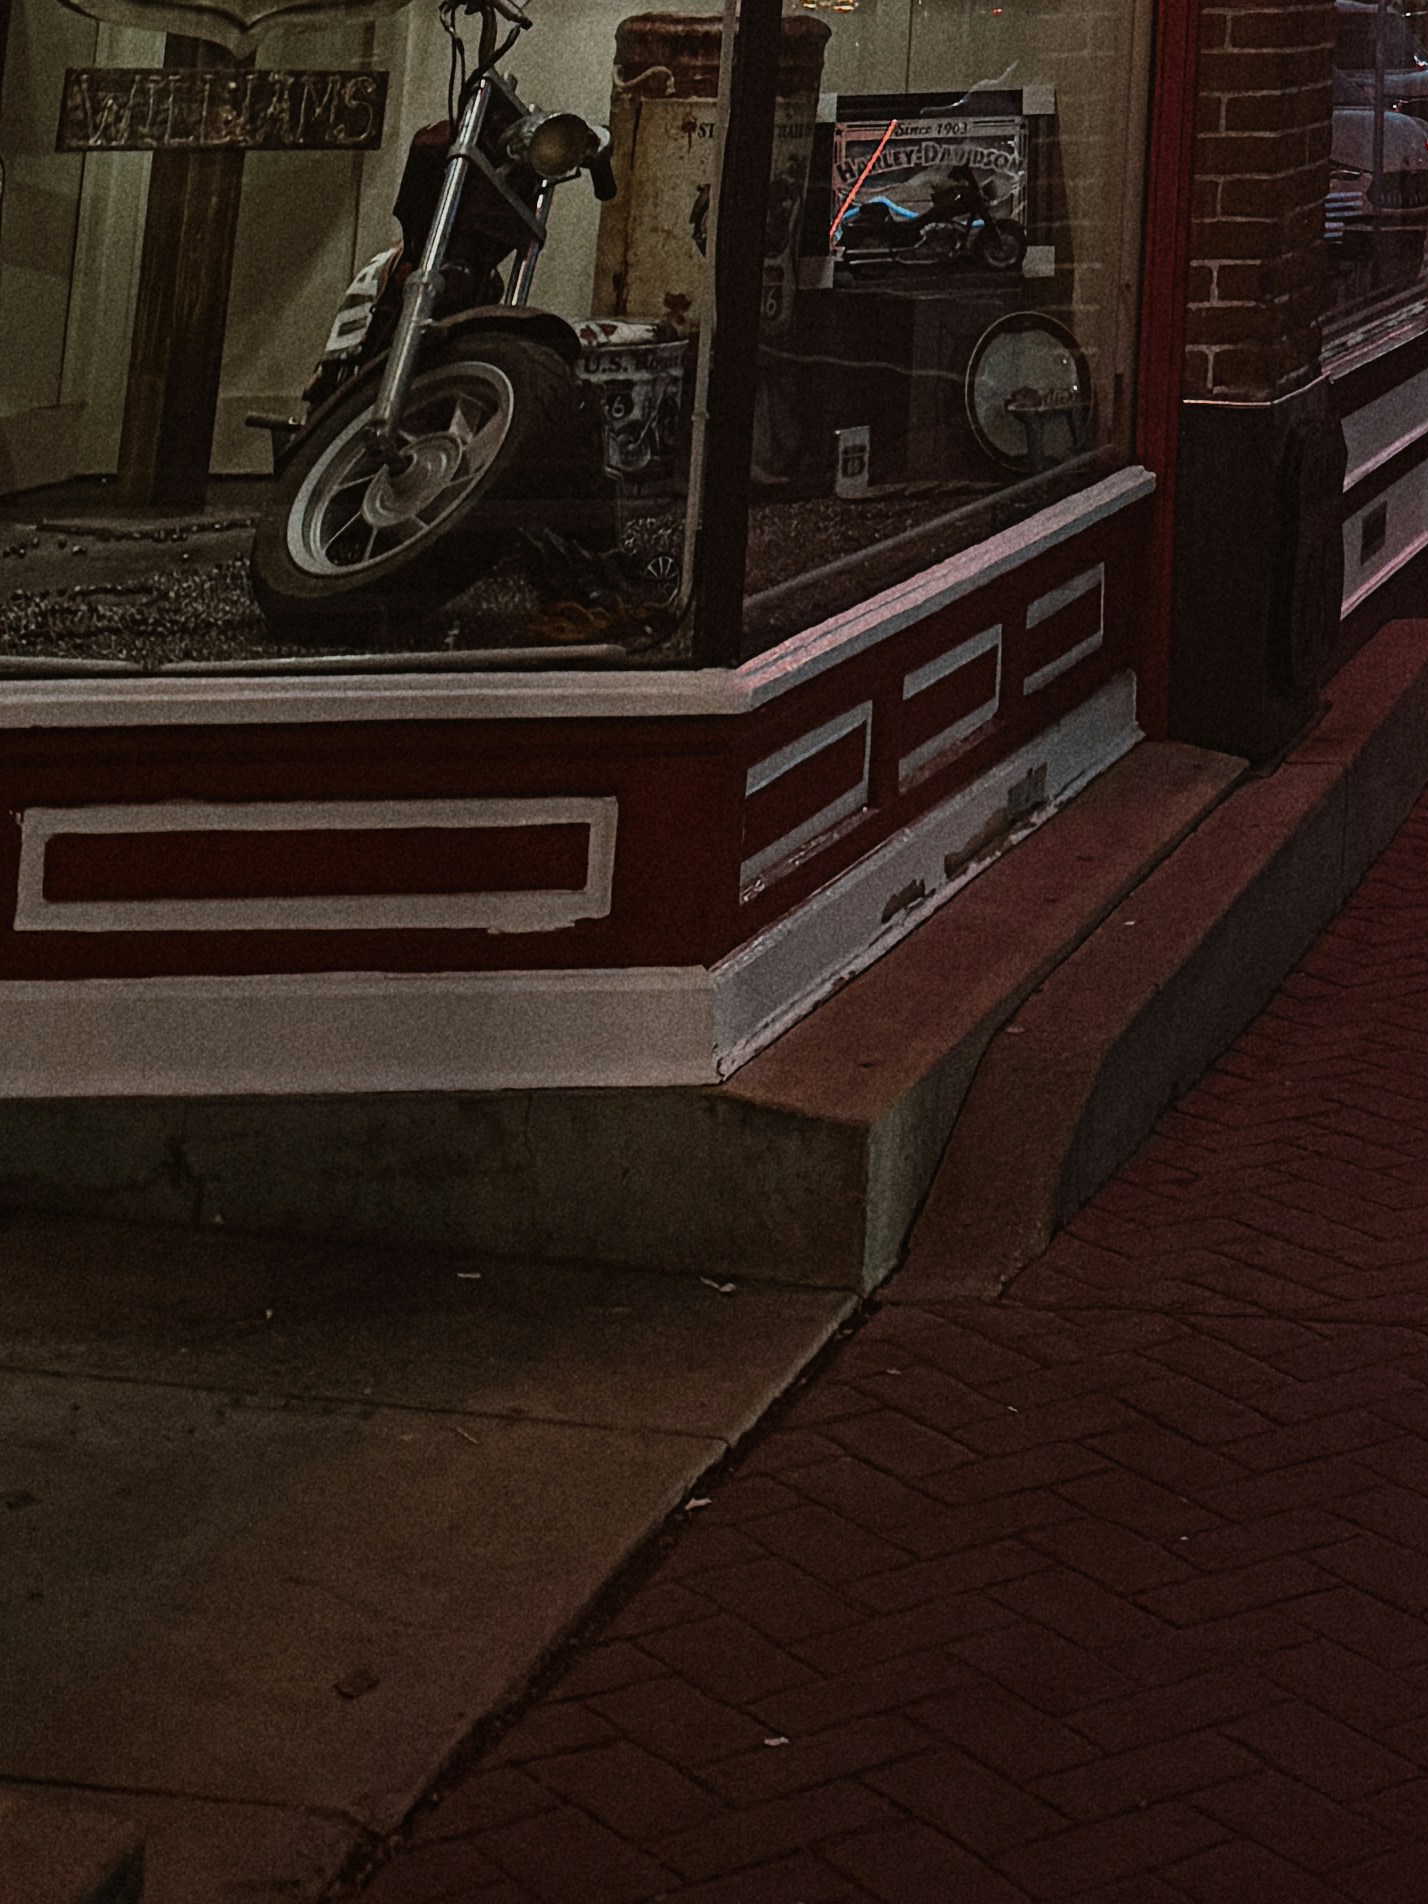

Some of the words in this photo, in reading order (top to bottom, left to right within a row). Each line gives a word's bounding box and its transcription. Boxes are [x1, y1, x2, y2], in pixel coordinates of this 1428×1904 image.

[70, 70, 380, 148] WILLIAMS
[894, 122, 932, 137] Since
[936, 122, 968, 137] 1903
